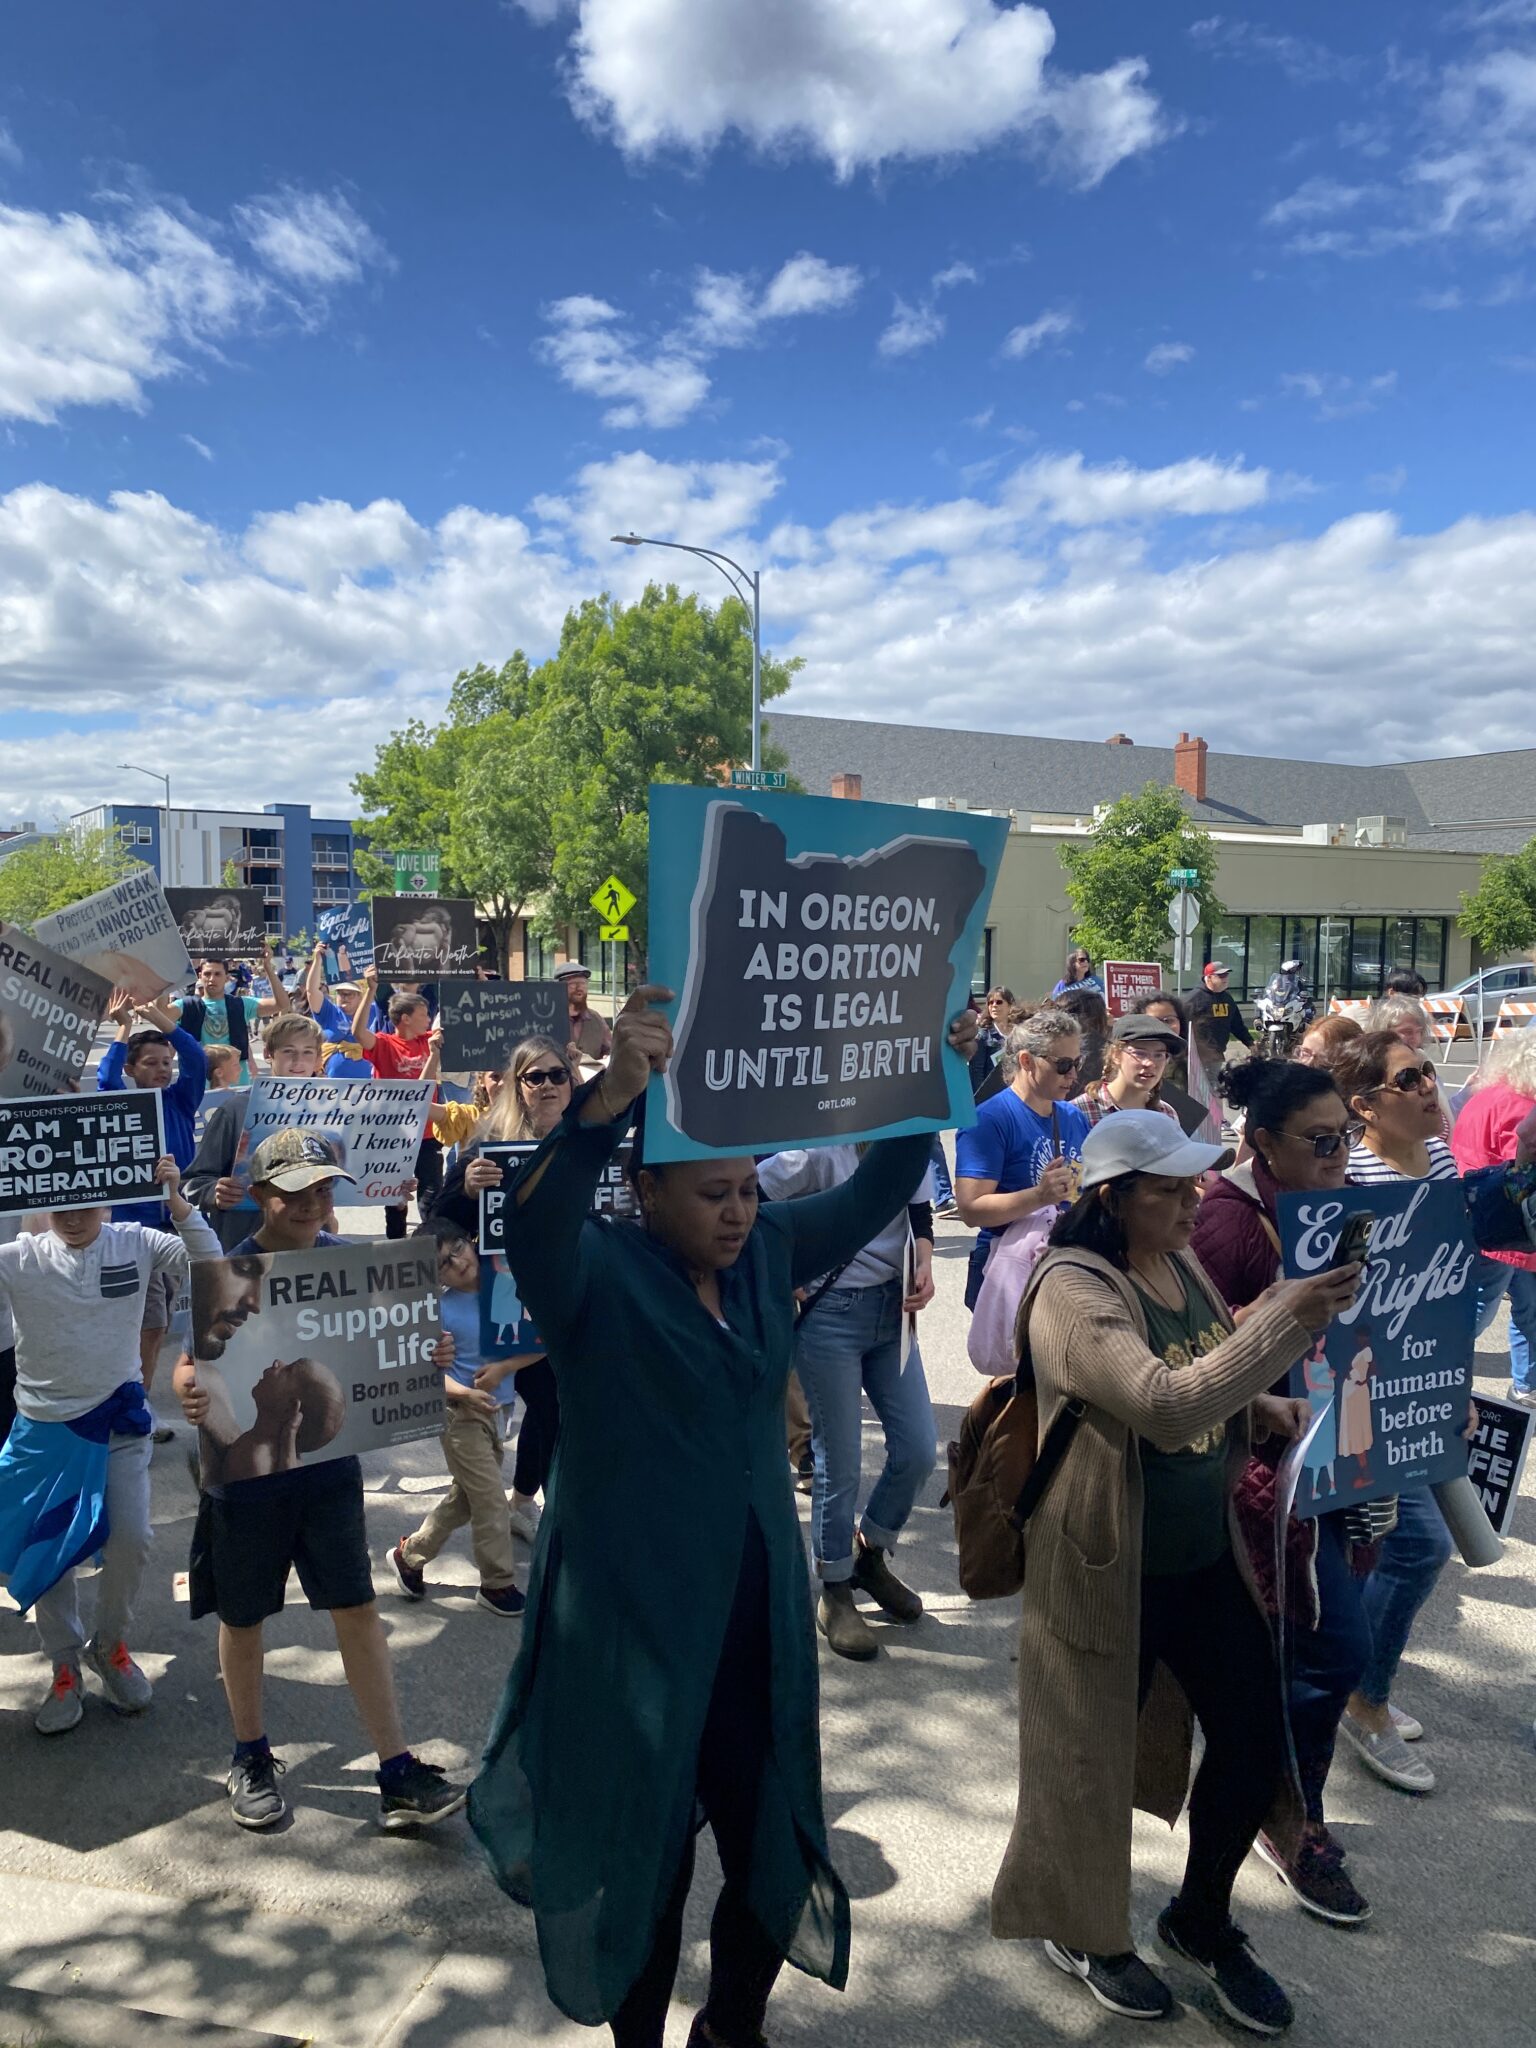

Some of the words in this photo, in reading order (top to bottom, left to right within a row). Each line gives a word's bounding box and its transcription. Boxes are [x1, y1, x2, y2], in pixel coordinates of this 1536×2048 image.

[735, 771, 766, 785] WINTER
[772, 773, 783, 786] ST
[396, 854, 420, 872] LOVE
[422, 854, 439, 872] LIFE
[56, 906, 96, 933] PROTECT
[99, 898, 114, 914] THE
[112, 873, 158, 906] WEAK.
[738, 889, 788, 929] IN
[800, 893, 940, 936] OREGON,
[319, 904, 352, 934] Equal
[331, 917, 370, 943] Rights
[81, 928, 98, 947] THE
[224, 926, 265, 944] Worth
[354, 940, 366, 949] for
[374, 943, 431, 967] Infinite
[435, 945, 480, 965] Worth
[743, 942, 922, 981] ABORTION
[0, 941, 52, 989] REAL
[58, 976, 108, 1016] MEN
[394, 968, 427, 977] conception
[1112, 973, 1128, 984] LET
[1130, 974, 1154, 985] THEIR
[2, 976, 98, 1042] Support
[458, 990, 474, 1009] A
[761, 993, 802, 1032] IS
[813, 989, 903, 1030] LEGAL
[463, 1012, 472, 1022] a
[476, 1007, 521, 1028] person
[485, 1026, 504, 1042] No
[17, 1048, 51, 1075] Born
[42, 1029, 86, 1068] Life
[462, 1044, 487, 1057] how
[704, 1046, 829, 1091] UNTIL
[839, 1036, 931, 1083] BIRTH
[259, 1081, 339, 1106] "Before
[343, 1084, 354, 1101] I
[352, 1083, 430, 1106] formed
[817, 1097, 857, 1111] ORTL.ORG
[13, 1102, 128, 1119] STUDENTSFORLIFE.ORG
[250, 1111, 290, 1130] you
[297, 1108, 318, 1126] in
[323, 1108, 354, 1126] the
[360, 1109, 419, 1129] womb,
[6, 1120, 61, 1142] AM
[77, 1113, 142, 1135] THE
[352, 1134, 363, 1150] I
[365, 1133, 417, 1150] knew
[0, 1134, 156, 1173] RO-LIFE
[0, 1164, 153, 1198] ENERATION
[27, 1196, 47, 1206] TEXT
[49, 1194, 67, 1204] LIFE
[69, 1193, 81, 1202] TO
[82, 1190, 108, 1201] 53445
[269, 1269, 357, 1306] REAL
[366, 1259, 437, 1293] MEN
[1338, 1239, 1475, 1341] Rights
[296, 1292, 439, 1342] Support
[377, 1332, 438, 1370] Life
[1401, 1334, 1437, 1362] for
[352, 1381, 400, 1403] Born
[406, 1372, 444, 1393] and
[1370, 1366, 1466, 1401] humans
[372, 1398, 443, 1426] Unborn
[1379, 1402, 1453, 1434] before
[1386, 1431, 1446, 1466] birth
